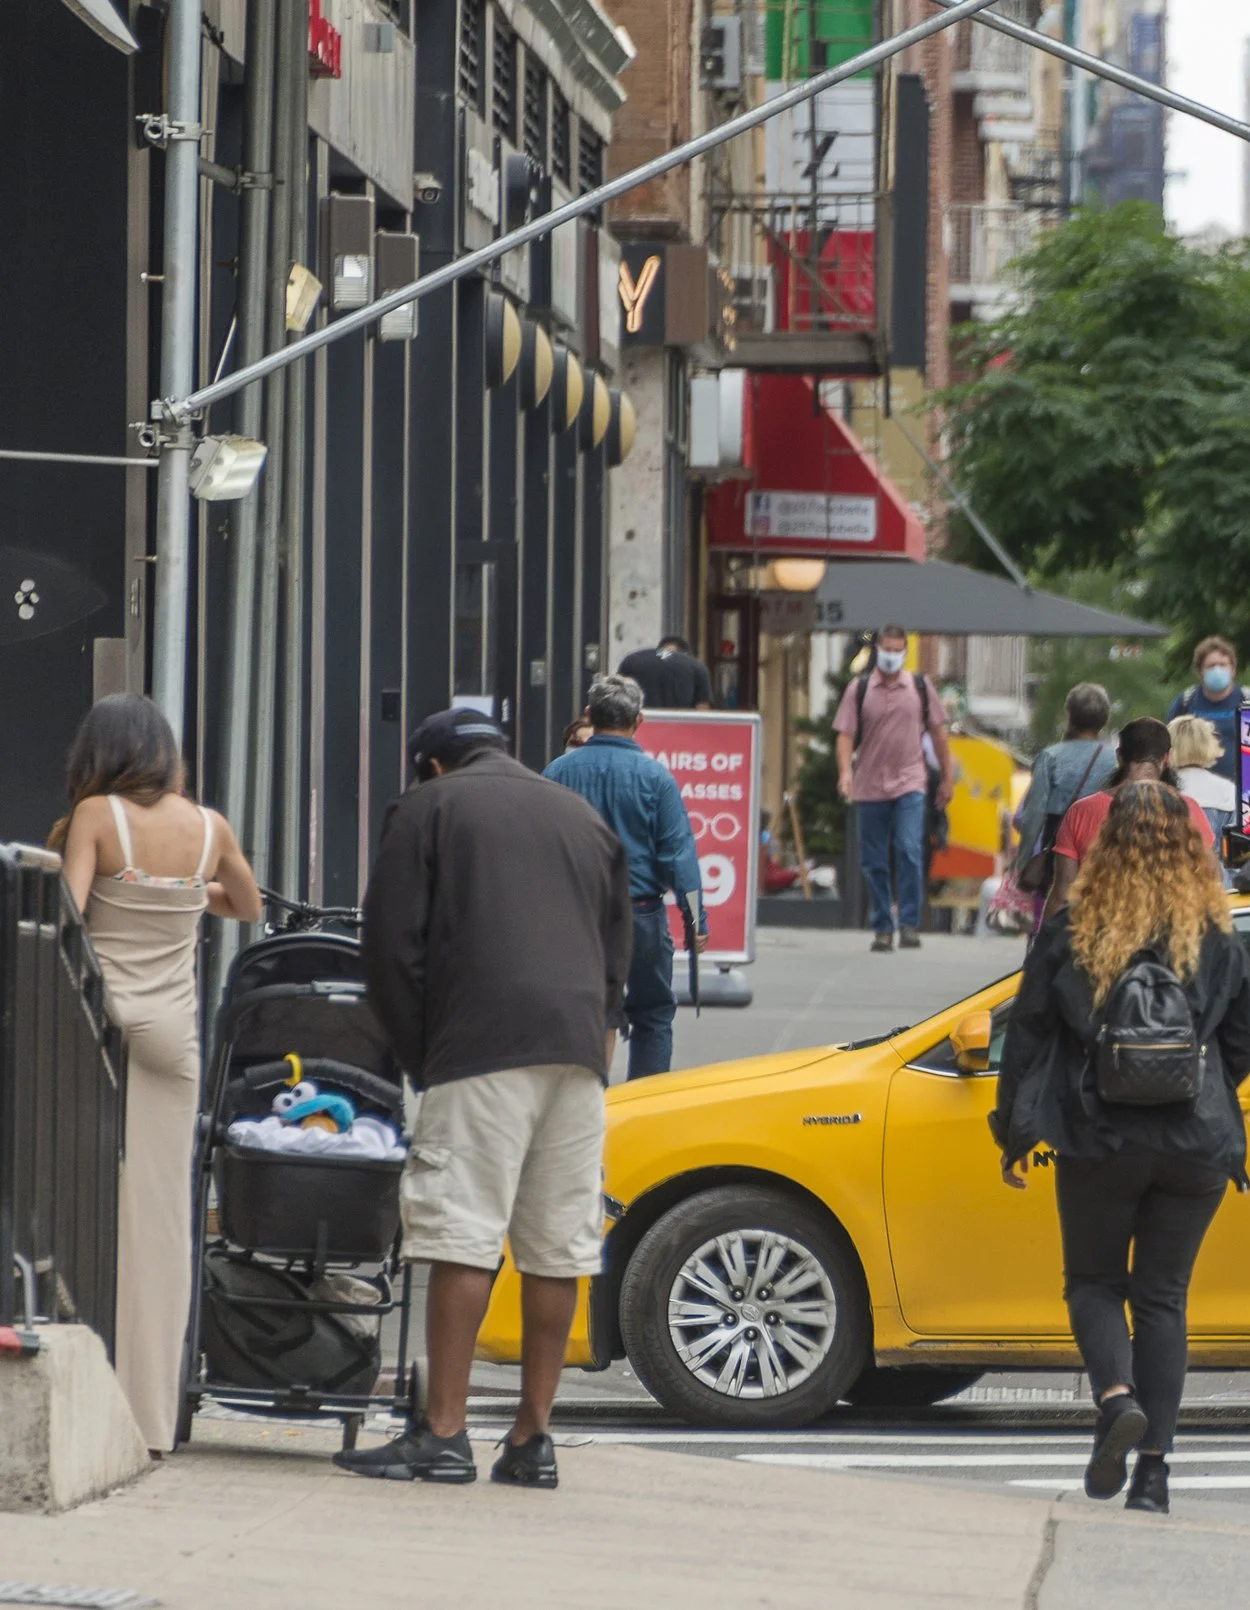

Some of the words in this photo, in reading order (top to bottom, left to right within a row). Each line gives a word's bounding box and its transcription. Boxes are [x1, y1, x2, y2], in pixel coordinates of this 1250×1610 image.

[711, 753, 744, 771] OF
[681, 783, 743, 801] ASSES
[803, 1116, 851, 1125] HYBRID
